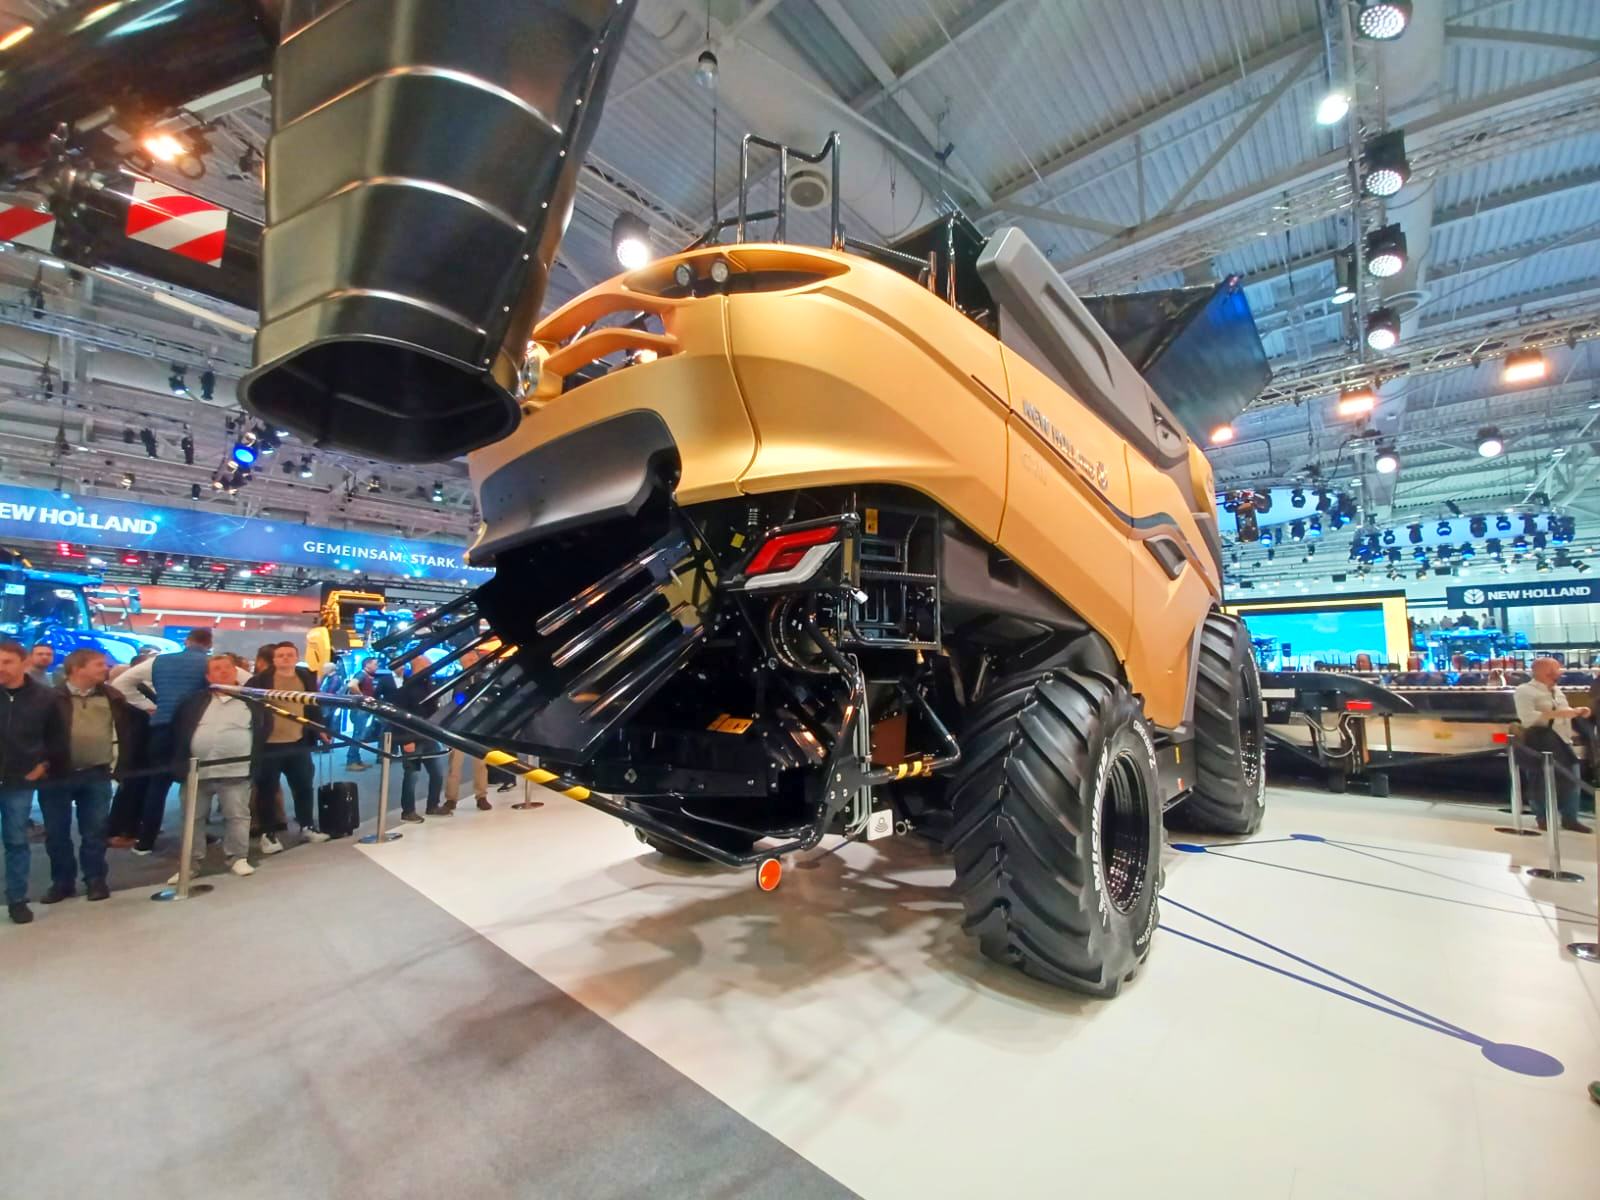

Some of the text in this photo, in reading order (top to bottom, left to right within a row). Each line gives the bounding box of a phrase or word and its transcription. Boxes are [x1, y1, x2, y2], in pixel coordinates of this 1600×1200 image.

[39, 507, 158, 535] HOLLAND
[303, 541, 406, 563] GEMEINSAM.
[410, 554, 459, 569] STARK.
[1488, 586, 1591, 600] NEW HOLLAND
